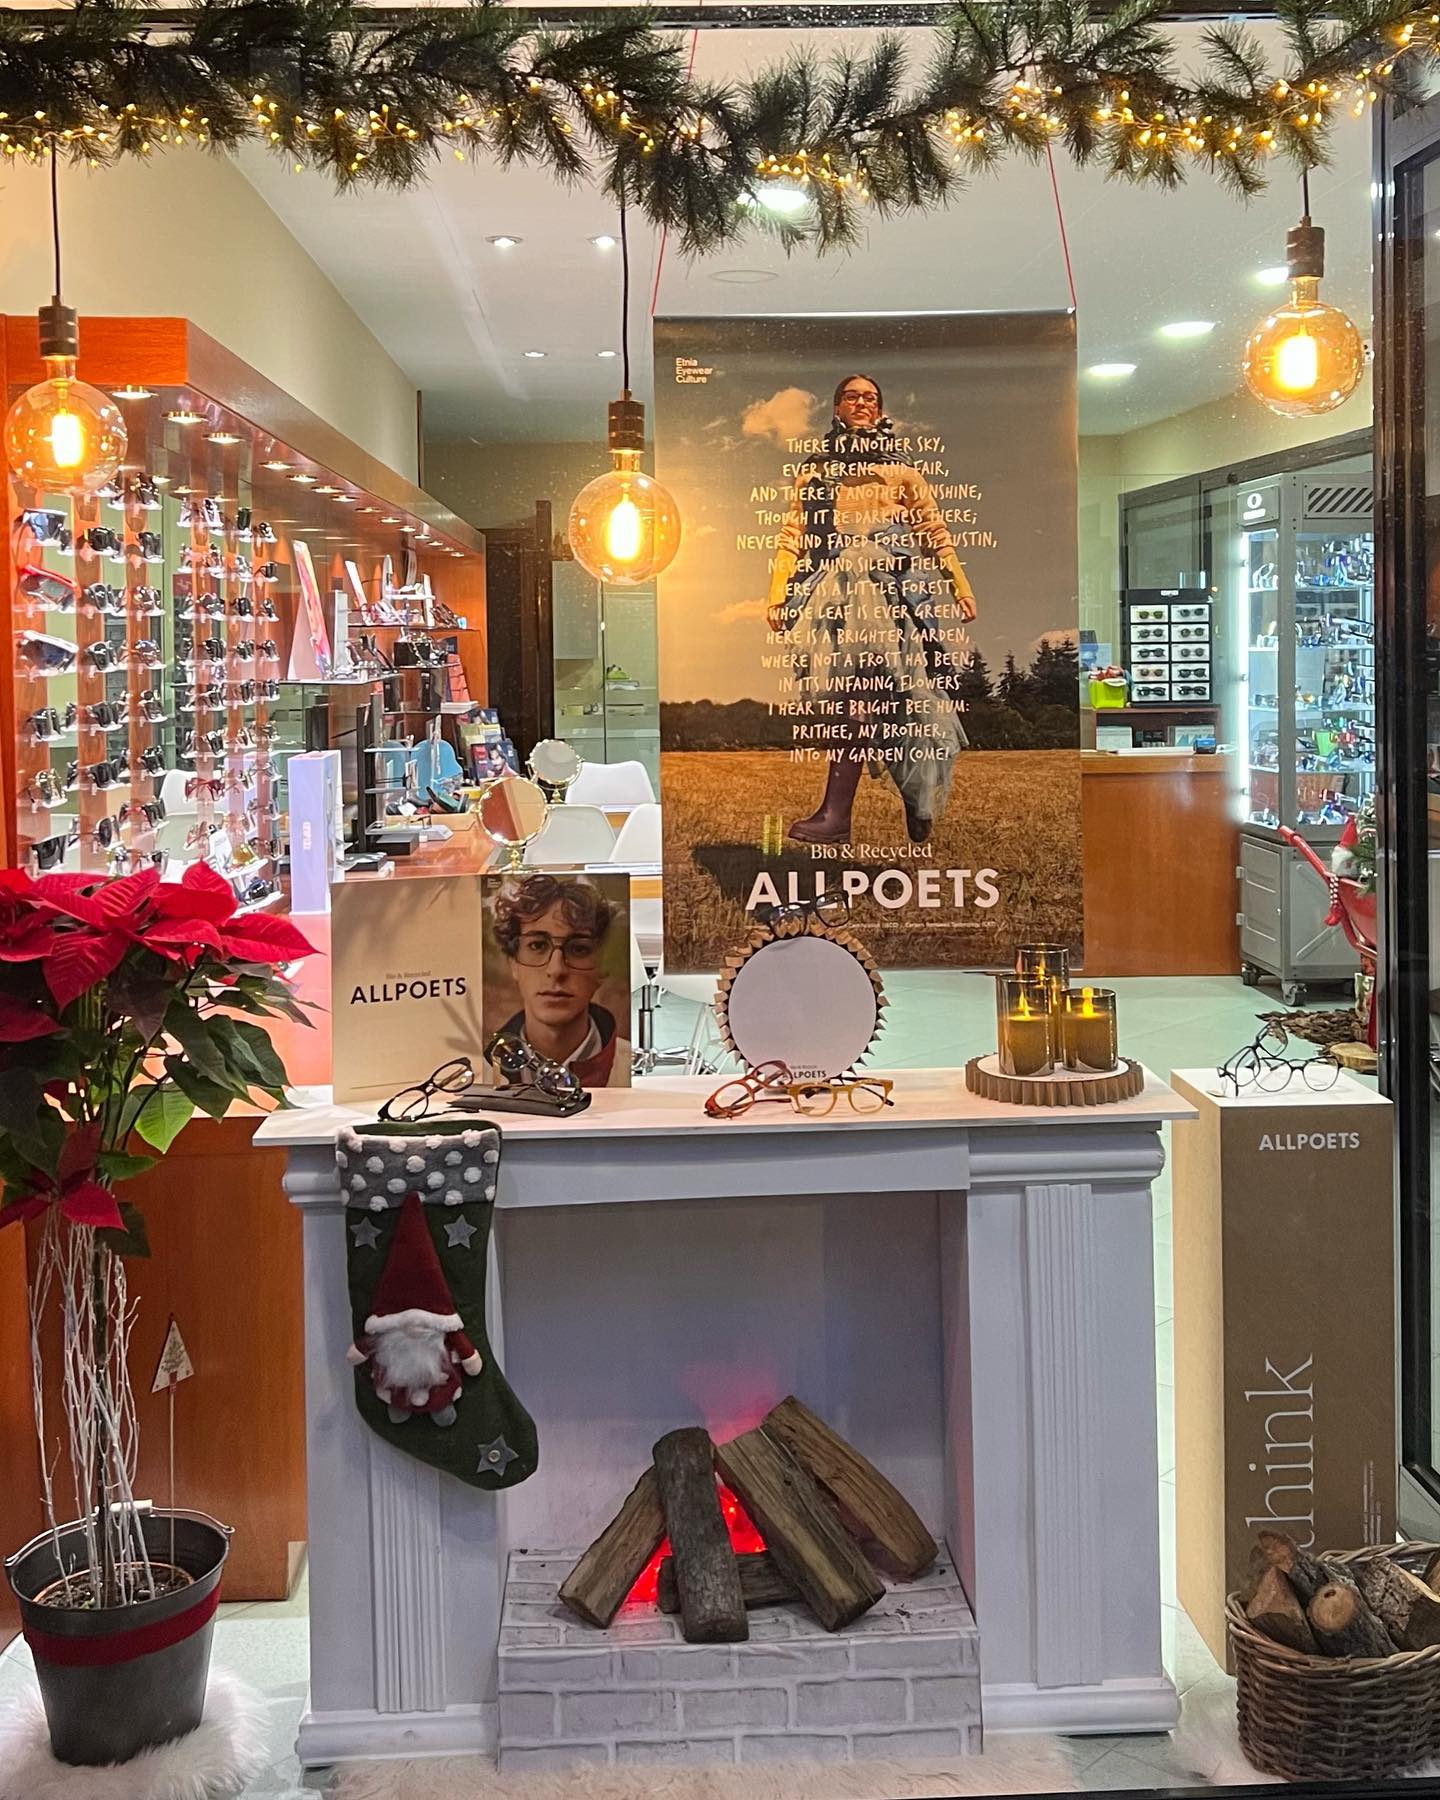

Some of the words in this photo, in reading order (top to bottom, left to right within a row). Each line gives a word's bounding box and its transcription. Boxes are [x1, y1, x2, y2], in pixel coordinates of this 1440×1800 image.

[786, 438, 830, 453] THERE
[835, 435, 848, 453] IS
[851, 437, 913, 453] ANOTHER
[917, 436, 945, 453] SKY,
[782, 462, 820, 477] EVER
[824, 462, 876, 477] SERENE
[881, 462, 906, 476] AND
[914, 460, 949, 477] FAIR,
[750, 487, 778, 502] AND
[781, 486, 825, 501] THERE
[830, 486, 840, 500] IS
[846, 485, 908, 500] ANOTHER
[912, 484, 982, 501] SUNSHINE,
[755, 510, 808, 526] THOUGH
[814, 509, 830, 525] IT
[833, 509, 848, 526] BE
[855, 508, 922, 525] DARKNESS
[927, 508, 977, 525] THERE;
[736, 534, 783, 551] NEVER
[827, 533, 868, 550] FADED
[942, 531, 998, 548] USTIN,
[768, 558, 814, 574] NEVER
[818, 559, 853, 573] MIND
[858, 556, 906, 572] SILENT
[910, 556, 952, 572] FIELDS
[817, 583, 827, 596] IS
[832, 583, 842, 595] A
[846, 580, 896, 595] LITTLE
[902, 579, 959, 597] FOREST,
[769, 605, 813, 621] WHOSE
[819, 604, 853, 620] LEAF
[857, 604, 868, 619] IS
[874, 604, 911, 619] EVER
[914, 604, 966, 619] GREEN,
[766, 630, 801, 645] HERE
[807, 628, 817, 645] IS
[822, 629, 831, 641] A
[837, 628, 906, 644] BRIGHTER
[910, 627, 970, 644] GARDEN,
[761, 654, 808, 669] WHERE
[814, 652, 841, 667] NOT
[844, 653, 853, 667] A
[859, 651, 901, 669] FROST
[905, 651, 928, 667] HAS
[779, 677, 793, 692] IN
[799, 677, 820, 692] ITS
[826, 675, 894, 693] UNFADING
[900, 674, 960, 692] FLOWERS
[768, 702, 773, 715] I
[779, 701, 815, 716] HEAR
[818, 700, 844, 715] THE
[849, 699, 900, 716] BRIGHT
[905, 699, 930, 715] BEE
[937, 700, 970, 714] HUM:
[792, 723, 853, 740] PRITHEE,
[858, 723, 878, 739] MY
[882, 722, 946, 740] BROTHER,
[789, 748, 820, 763] INTO
[825, 748, 844, 763] MY
[848, 747, 903, 763] GARDEN
[909, 747, 950, 763] COME!
[811, 844, 837, 859] Bio
[841, 843, 854, 858] &
[860, 842, 933, 861] Recycled
[745, 868, 1000, 910] ALLPOETS
[350, 977, 466, 1005] ALLPOETS
[782, 1070, 826, 1080] ALPOETS
[1259, 1132, 1360, 1151] ALLPOETS
